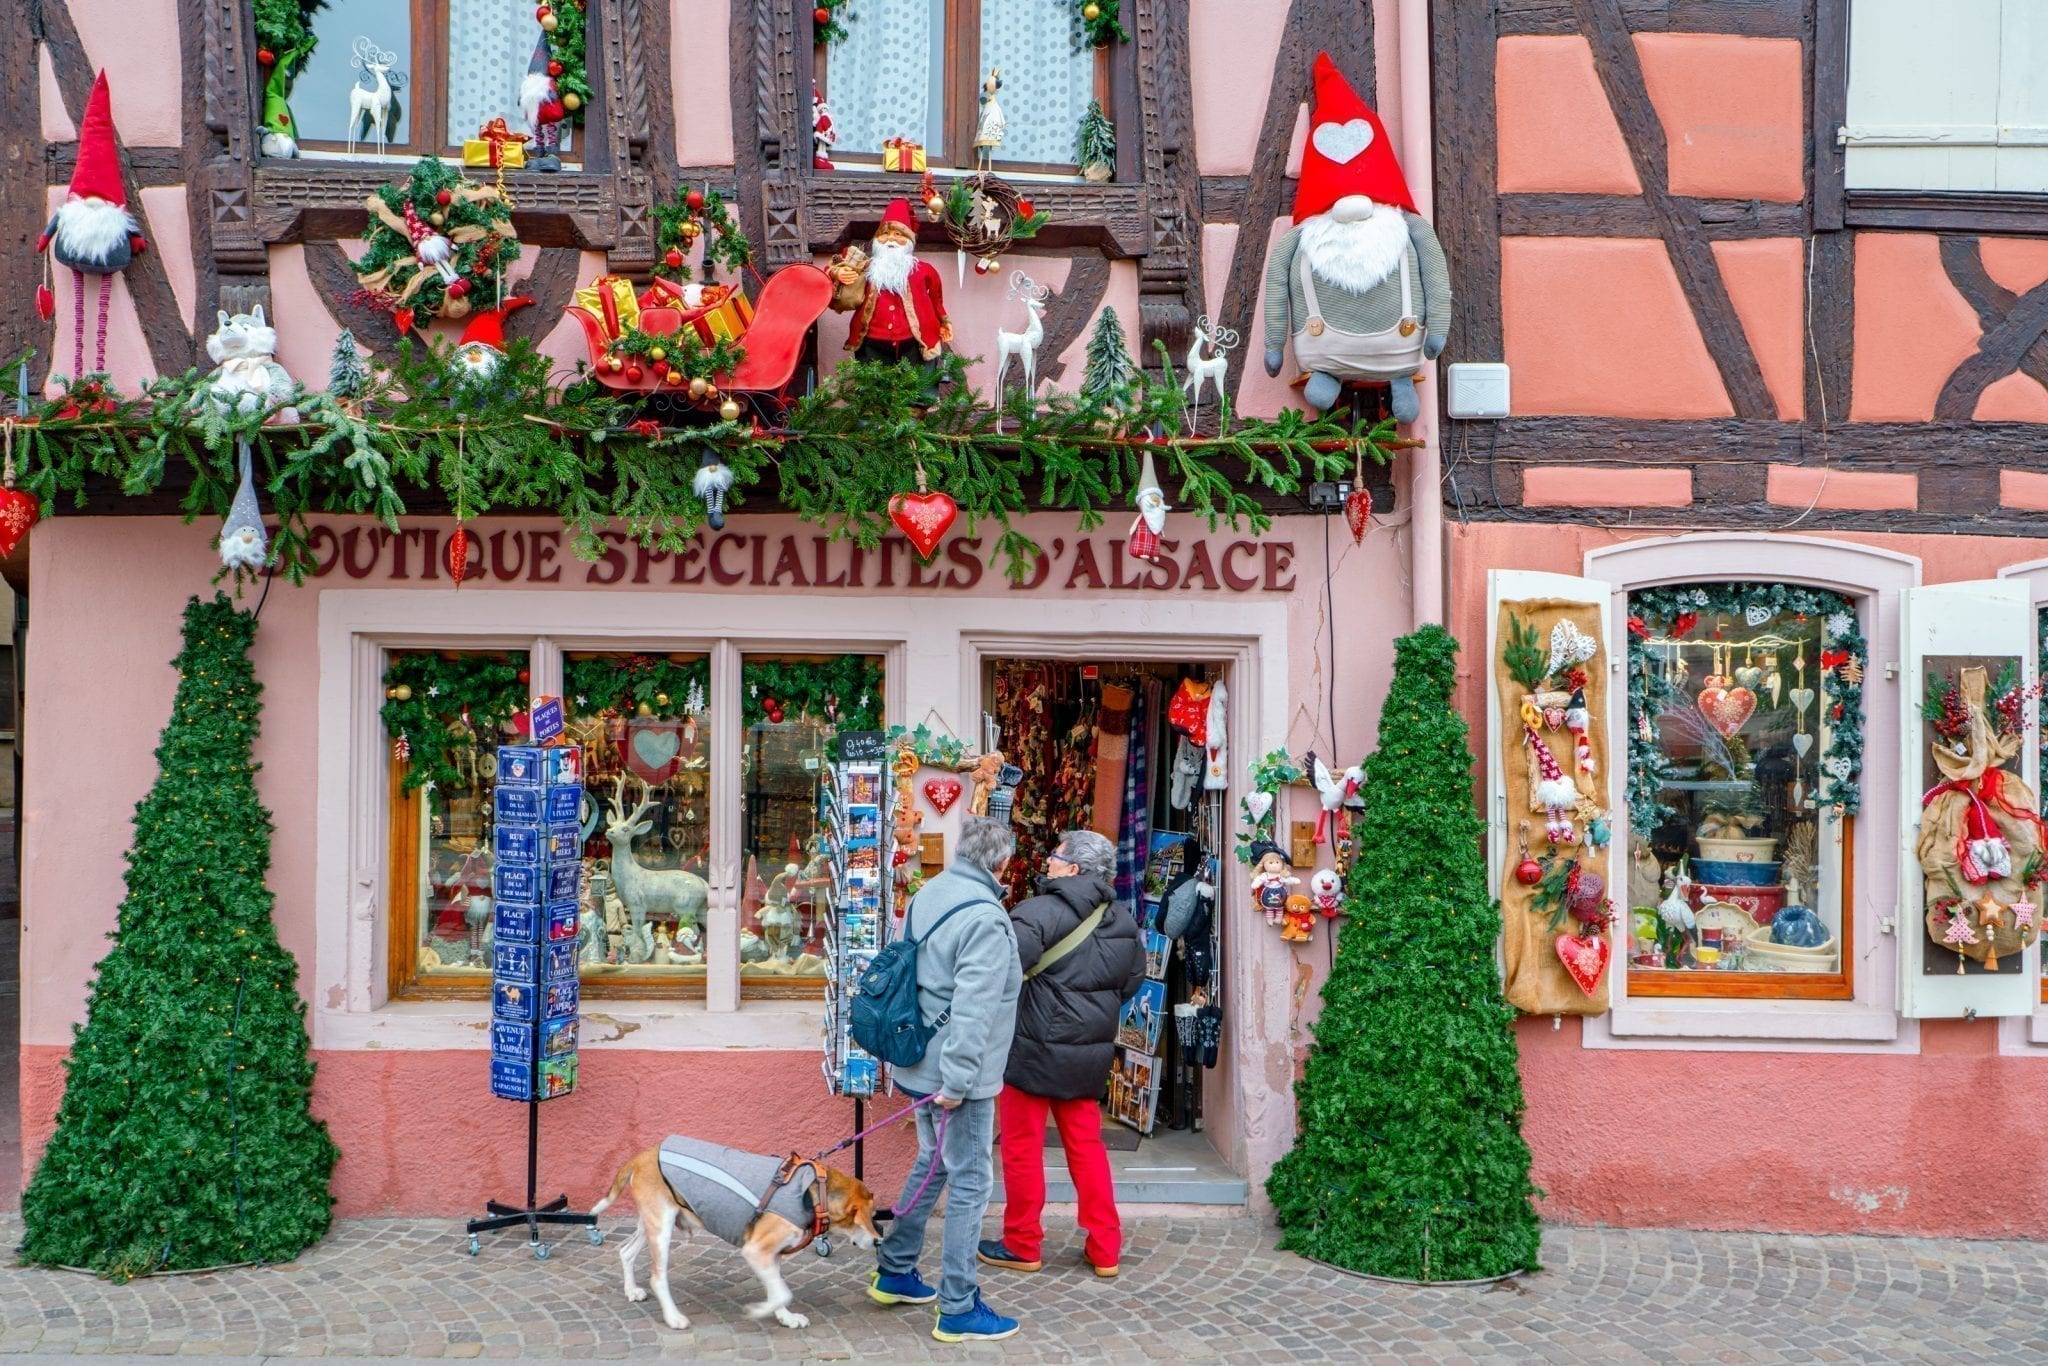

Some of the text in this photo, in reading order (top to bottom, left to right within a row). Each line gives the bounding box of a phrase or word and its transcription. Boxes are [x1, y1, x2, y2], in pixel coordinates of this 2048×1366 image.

[259, 525, 562, 583] OUTIQUE
[1009, 538, 1298, 592] D'ALSACE
[534, 706, 558, 724] PLAQUES
[539, 722, 560, 738] PORTES
[508, 793, 524, 801] RUE
[509, 833, 524, 841] RUE
[504, 871, 526, 880] PLACE
[557, 870, 574, 880] PLACE
[503, 910, 526, 920] PLACE
